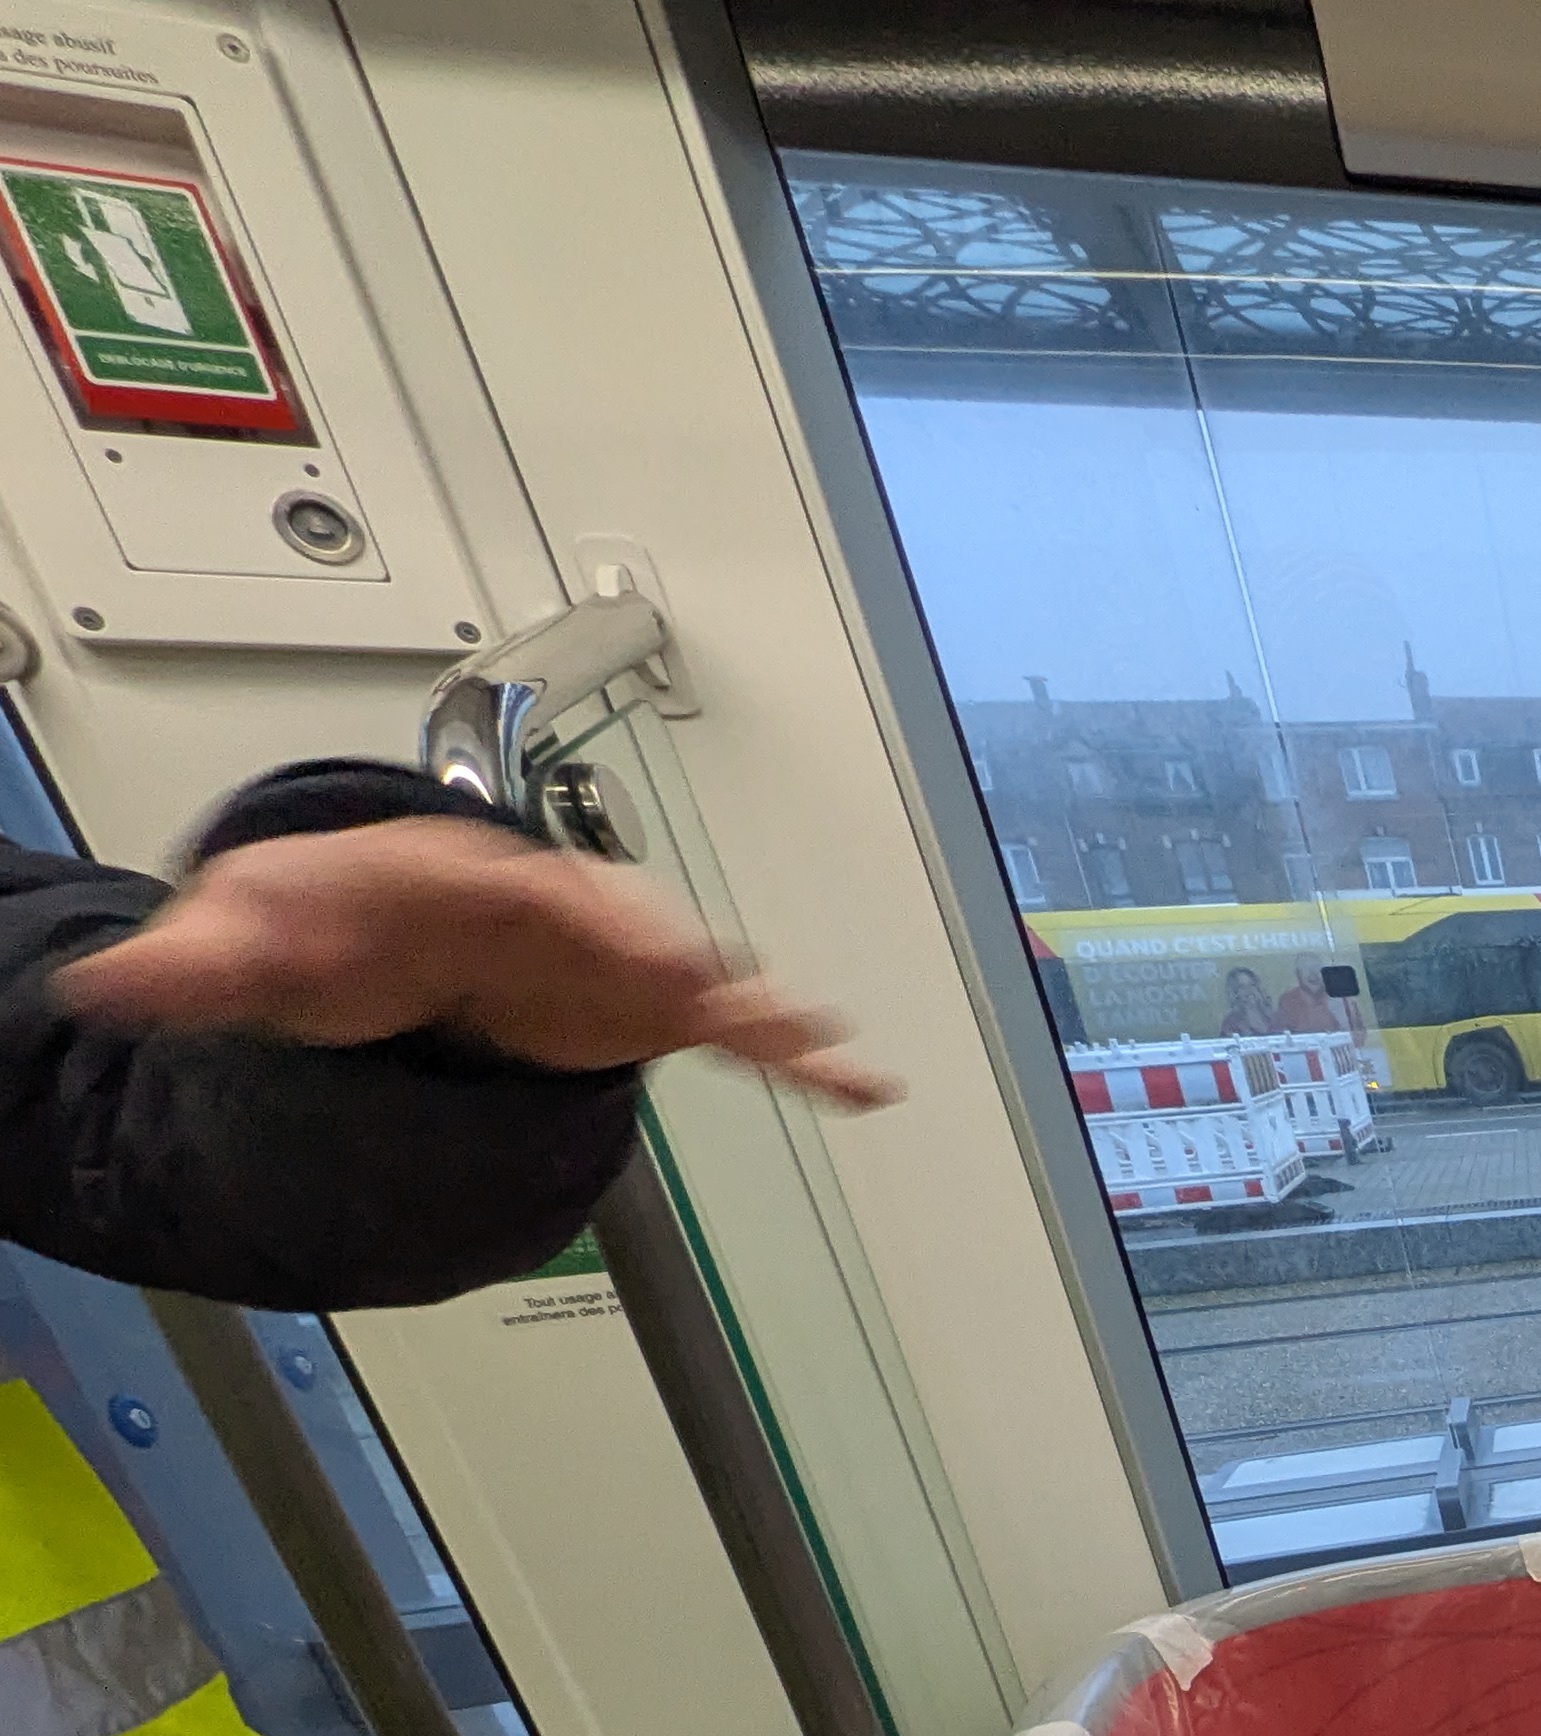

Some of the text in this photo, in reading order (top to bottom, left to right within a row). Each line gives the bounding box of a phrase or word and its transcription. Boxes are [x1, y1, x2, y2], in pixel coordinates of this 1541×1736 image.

[53, 31, 116, 55] abusif
[13, 49, 48, 68] des
[53, 57, 159, 84] poursuites
[1076, 930, 1337, 961] QUAND C'EST L'HEUR
[559, 1292, 602, 1305] usage
[579, 1306, 605, 1317] des
